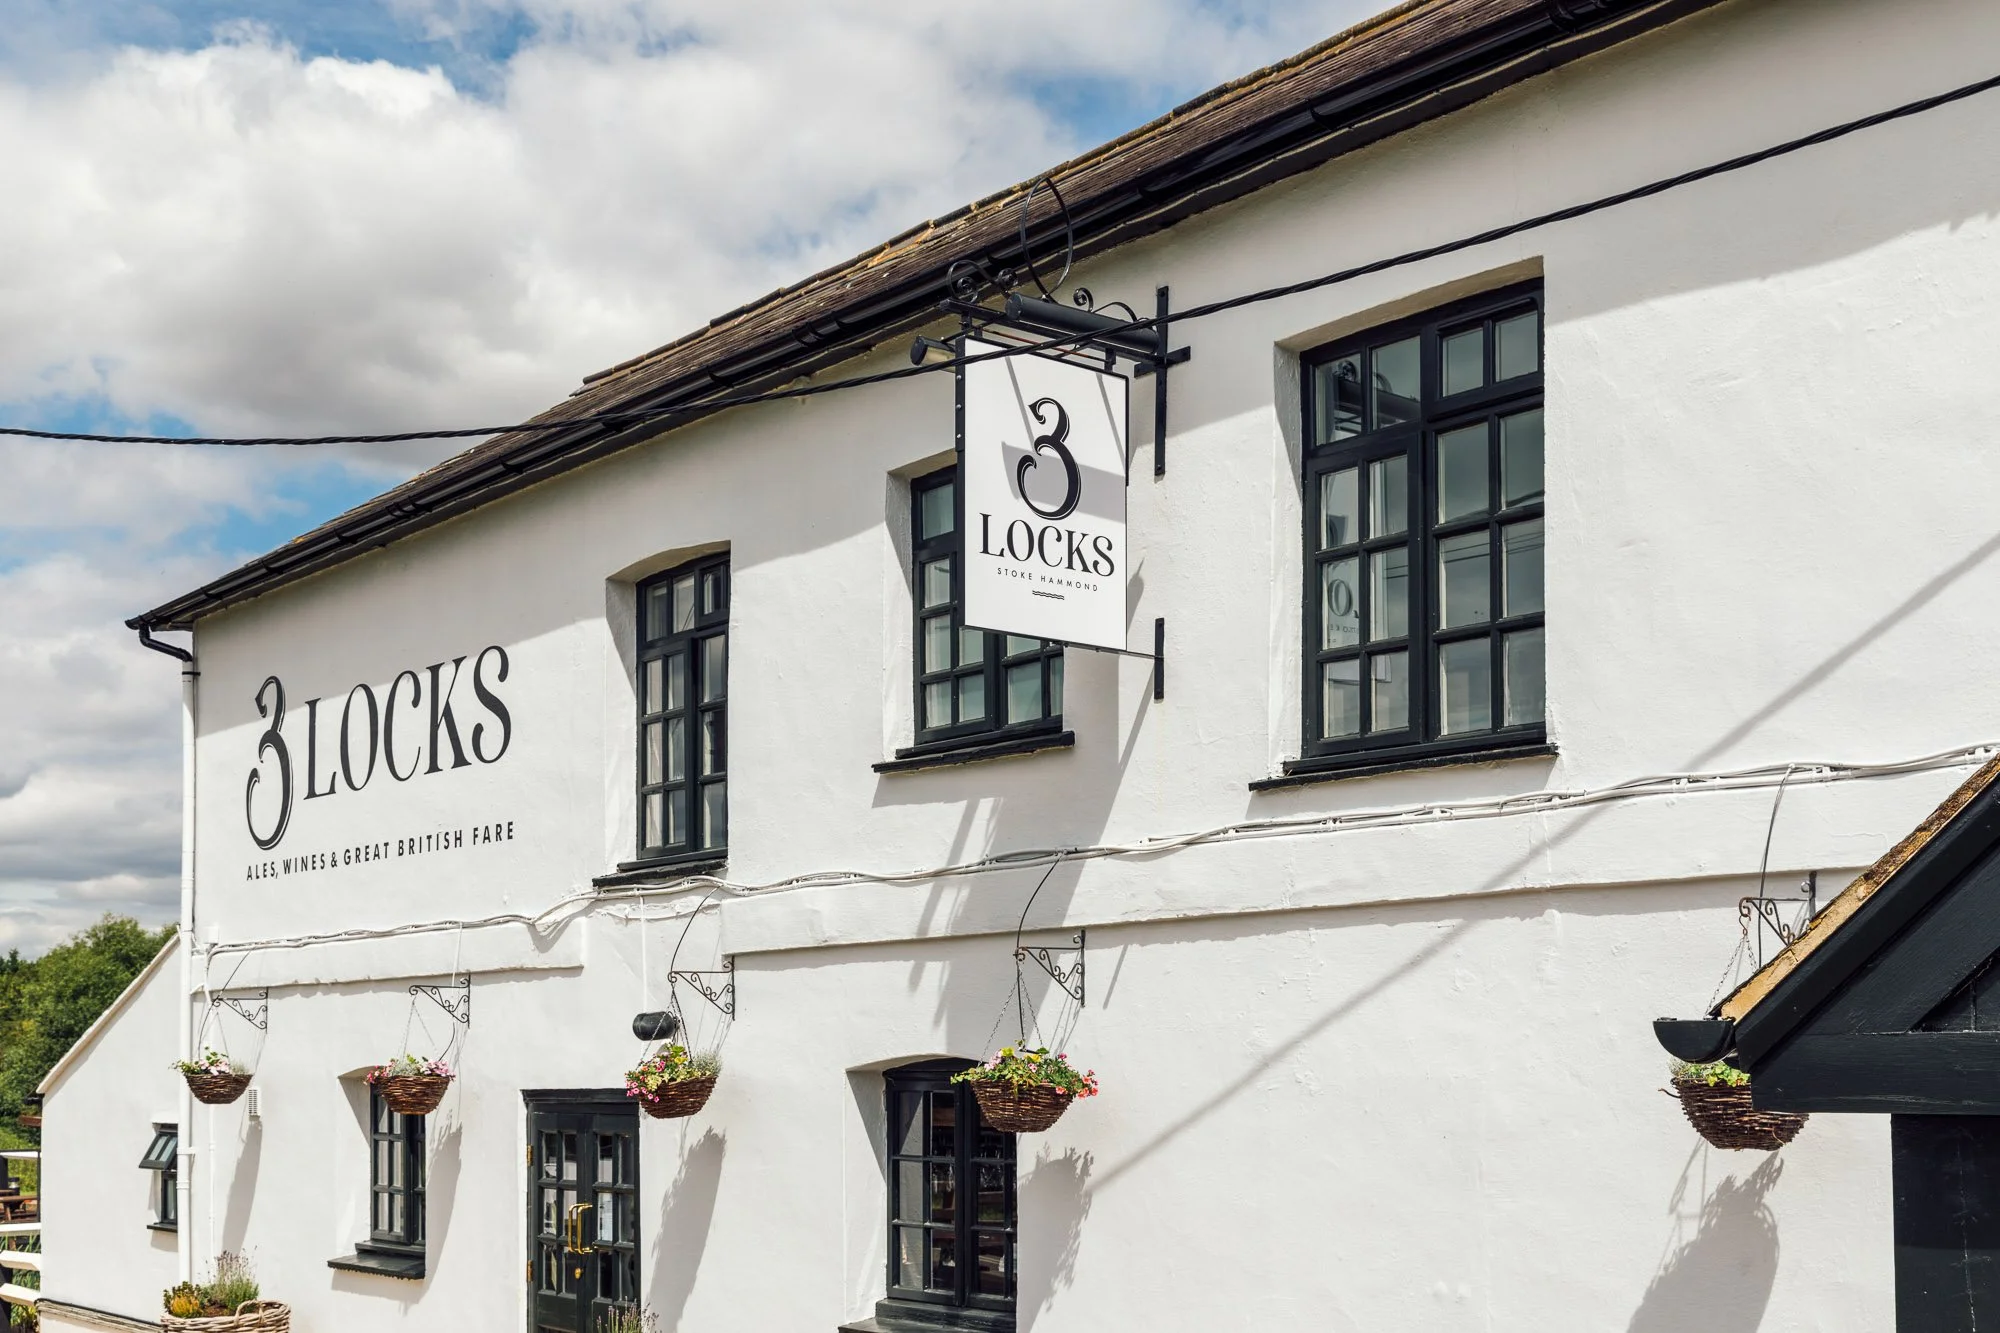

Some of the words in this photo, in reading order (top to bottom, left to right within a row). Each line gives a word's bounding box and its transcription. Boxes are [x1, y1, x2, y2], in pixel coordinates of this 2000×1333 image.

[1016, 397, 1082, 521] 3
[979, 512, 1116, 578] LOCKS
[997, 567, 1034, 581] STOKE
[1040, 574, 1099, 592] HAMMOND
[246, 675, 294, 851] 3
[303, 645, 512, 801] LOCKS
[246, 860, 279, 881] ALES,
[282, 852, 326, 875] WINES
[330, 851, 338, 868] &
[343, 841, 390, 866] GREAT
[397, 829, 463, 857] BRITISH
[472, 820, 514, 846] FARE
